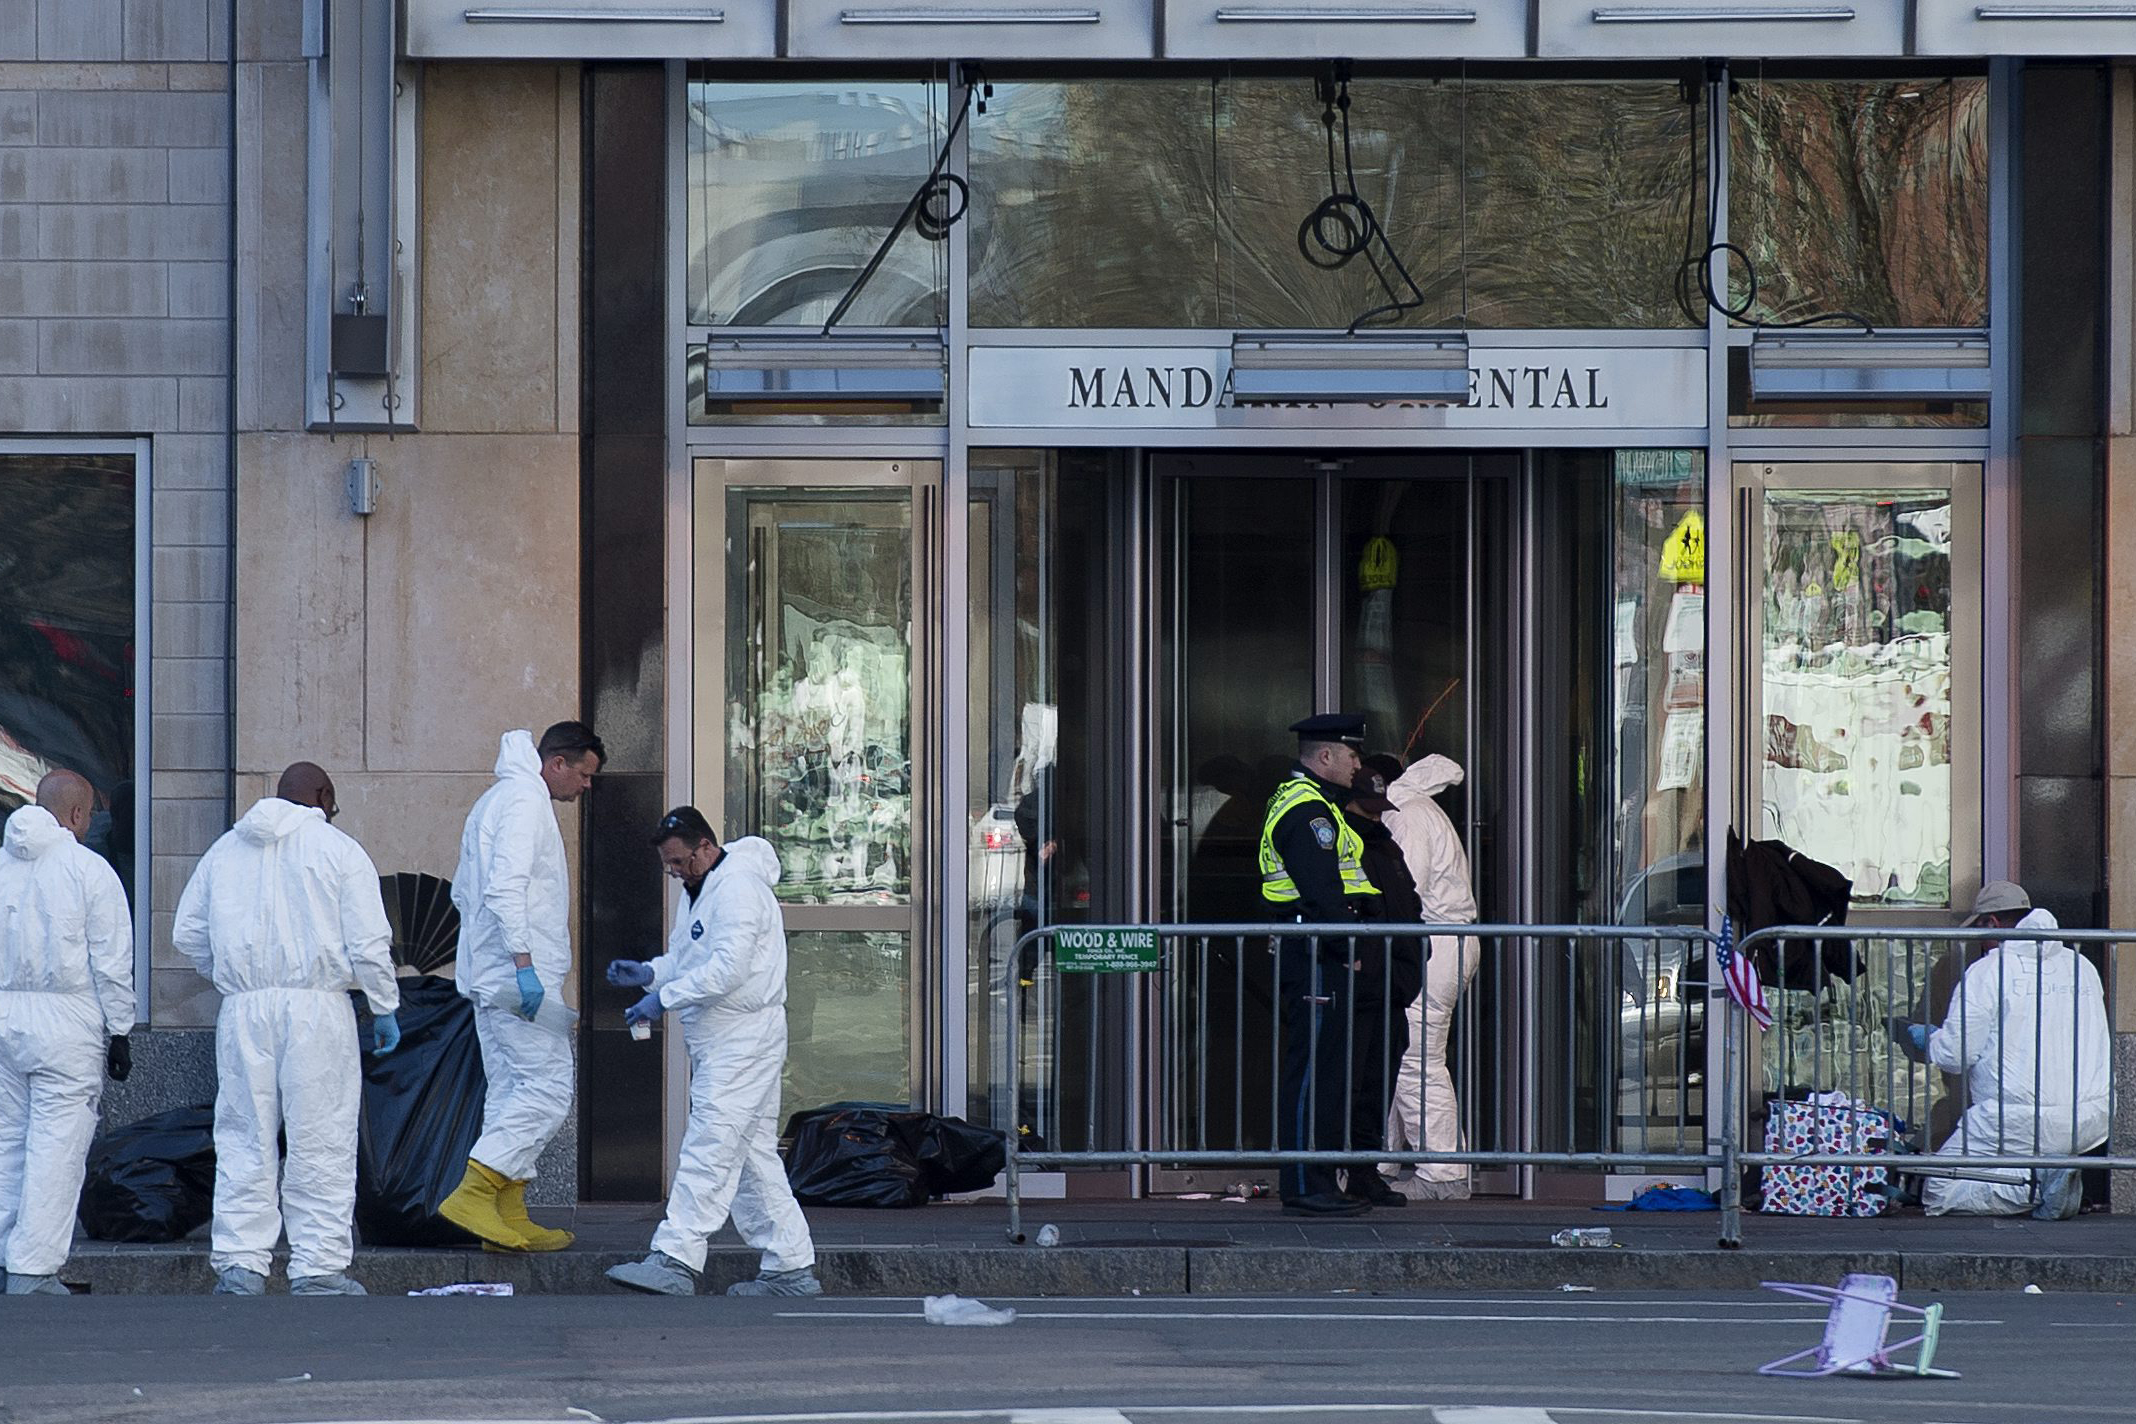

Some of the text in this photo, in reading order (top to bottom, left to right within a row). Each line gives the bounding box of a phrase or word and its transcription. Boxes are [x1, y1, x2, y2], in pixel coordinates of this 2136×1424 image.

[1068, 366, 1610, 410] MANDA ENTAL
[1059, 931, 1155, 949] WOOD & WIRE
